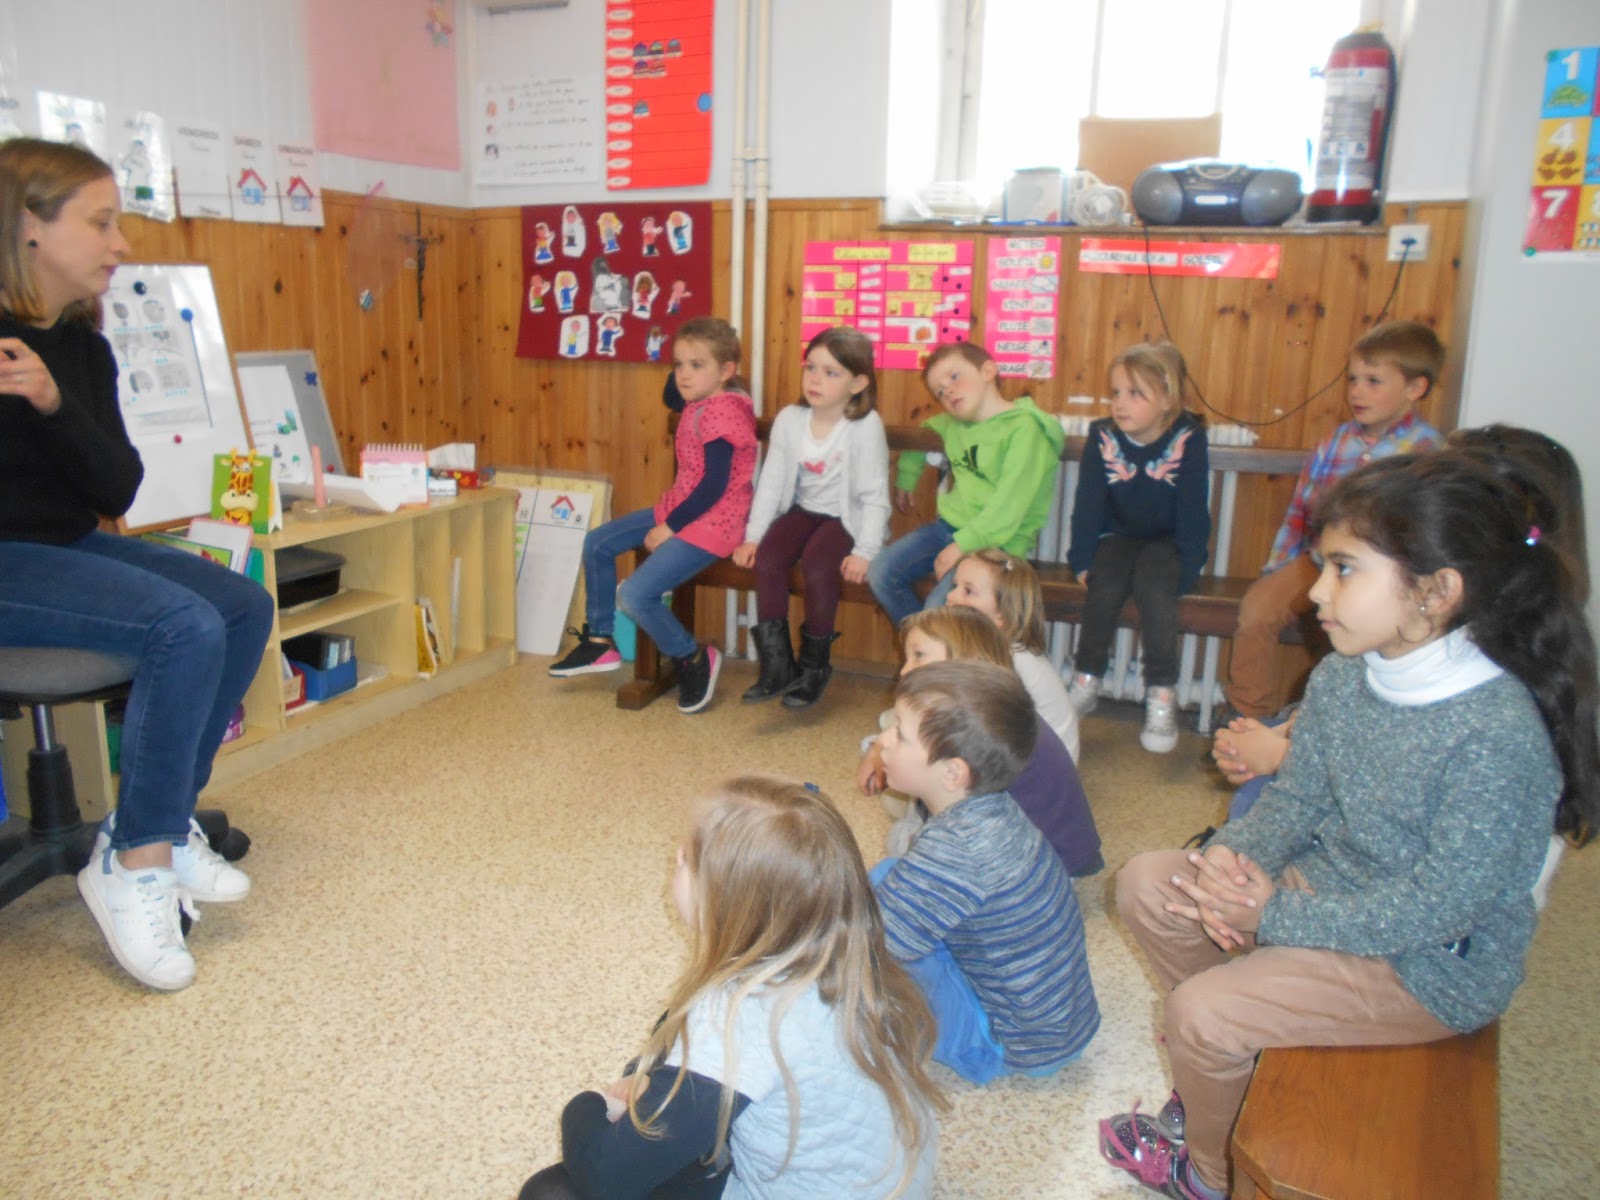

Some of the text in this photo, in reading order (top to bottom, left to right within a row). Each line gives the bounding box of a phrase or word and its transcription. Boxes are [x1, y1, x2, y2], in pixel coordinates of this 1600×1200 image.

[1561, 50, 1581, 81] 1
[1547, 121, 1574, 150] 4
[1541, 189, 1569, 220] 7
[998, 257, 1034, 267] SOLEIL
[993, 280, 1029, 289] NUAGE
[1003, 299, 1031, 309] VENT
[999, 321, 1028, 331] PLUIE
[997, 342, 1029, 352] NEIGE
